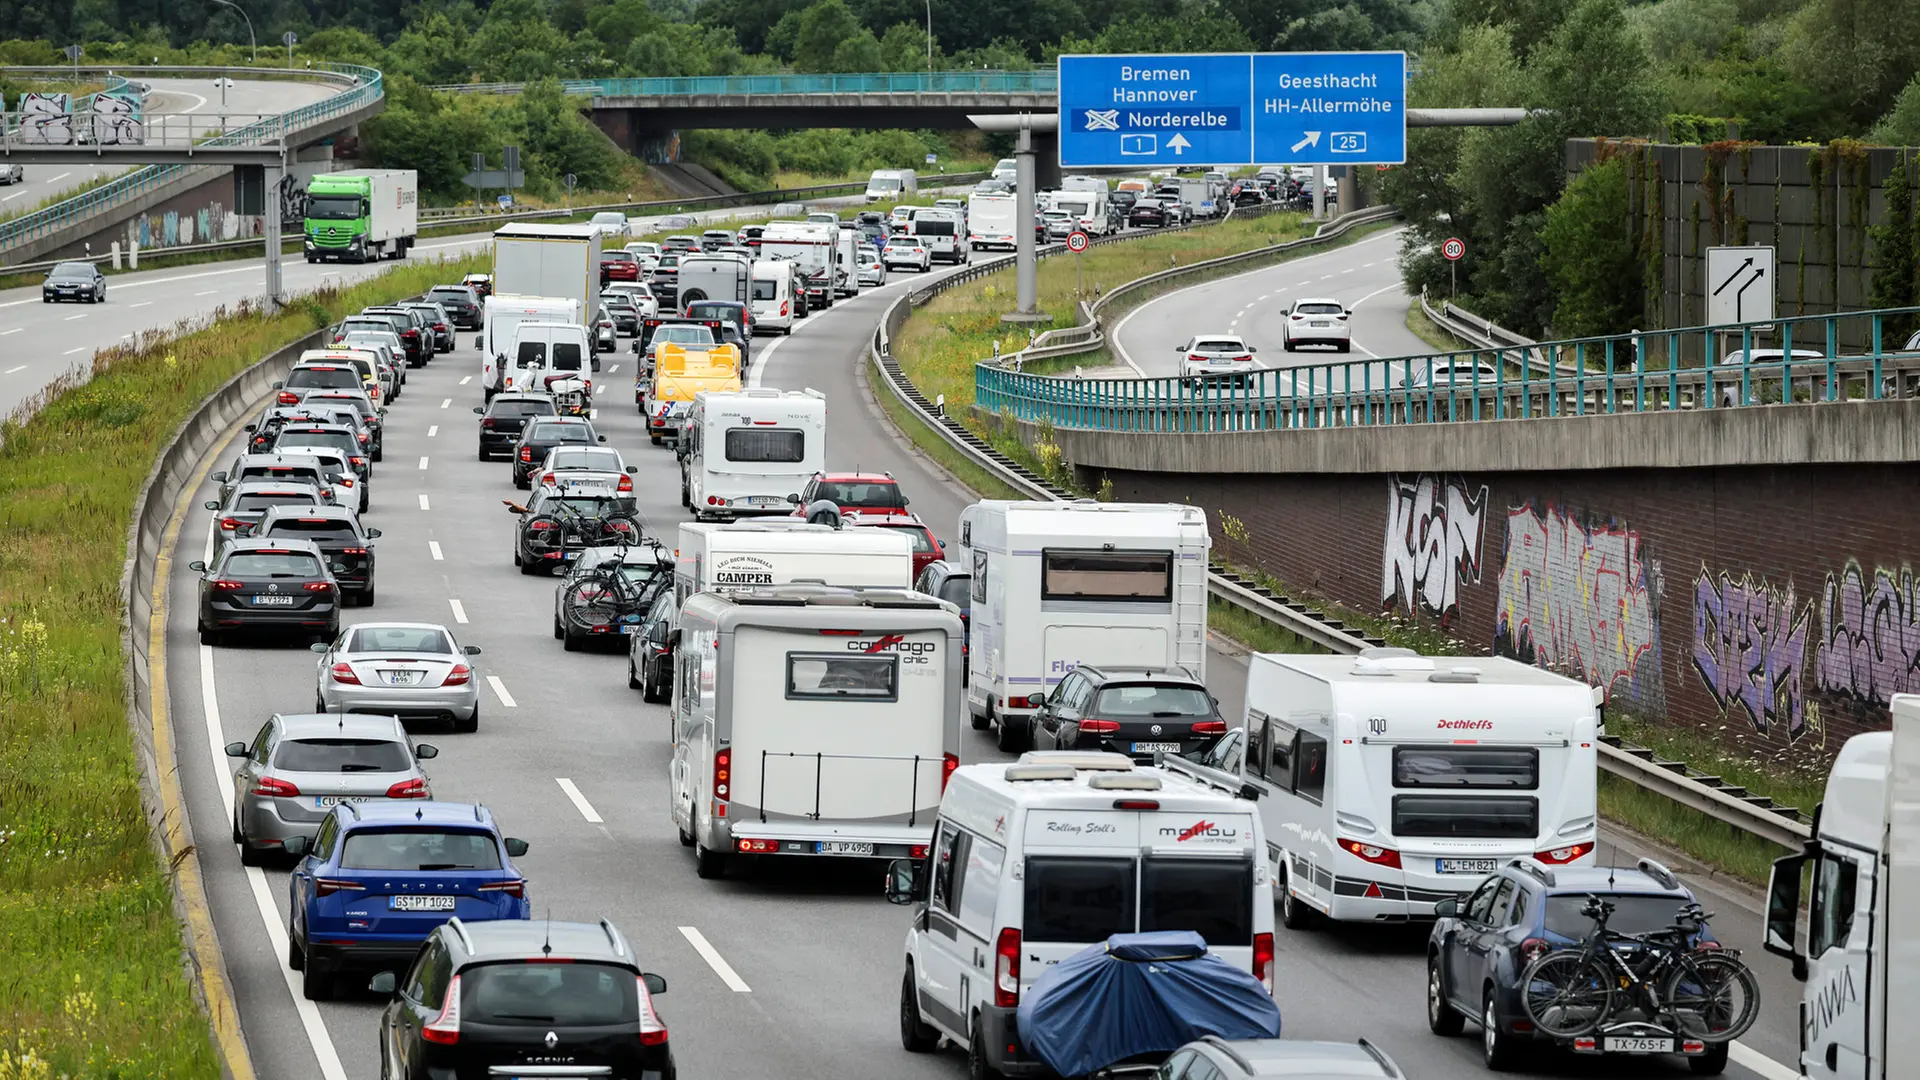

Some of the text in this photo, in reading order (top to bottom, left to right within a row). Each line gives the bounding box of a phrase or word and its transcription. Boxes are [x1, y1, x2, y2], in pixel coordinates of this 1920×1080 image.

[1121, 66, 1190, 82] Bremen
[1279, 73, 1377, 89] Geesthacht
[1113, 87, 1198, 102] Hannover
[1264, 98, 1392, 114] HH-Allermöhe
[1129, 112, 1228, 127] Norderelbe
[1136, 138, 1142, 151] 1
[1340, 136, 1357, 149] 25
[1071, 236, 1084, 247] 80
[1446, 244, 1460, 254] 80
[716, 572, 773, 583] CAMPER
[847, 640, 936, 656] carthago
[903, 656, 928, 664] chic
[1368, 718, 1387, 733] 100
[1437, 719, 1493, 730] Dethleffs
[1047, 822, 1082, 834] Rolling
[1159, 825, 1236, 837] malibu
[851, 843, 872, 853] 4950
[1443, 860, 1495, 871] WL EM 821
[395, 896, 454, 908] GS PT 1023
[1613, 1039, 1666, 1050] TX-765-F
[526, 1056, 575, 1064] SCENIC
